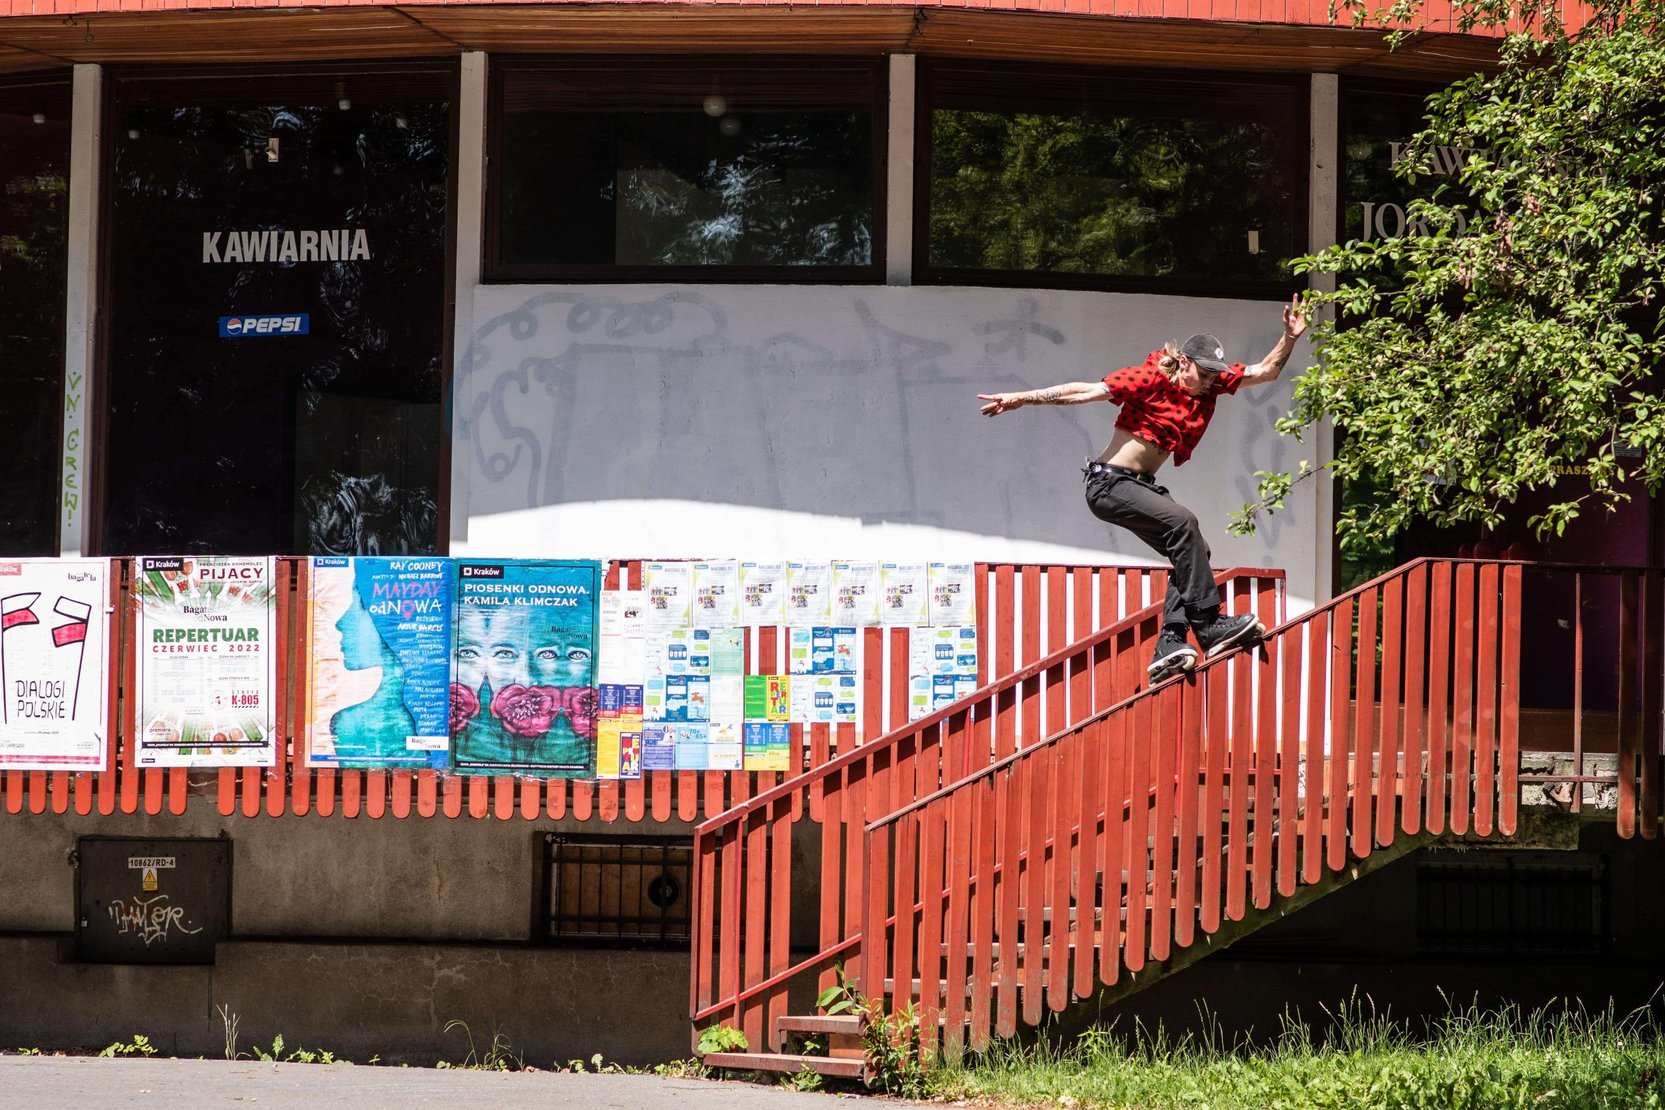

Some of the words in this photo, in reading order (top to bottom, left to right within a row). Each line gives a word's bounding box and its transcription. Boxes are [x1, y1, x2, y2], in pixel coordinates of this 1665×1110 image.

[202, 228, 371, 263] KAWIARNIA
[242, 316, 301, 334] PEPSI
[155, 560, 180, 568] Kraków
[324, 558, 346, 566] Kraków
[390, 561, 408, 571] RAY
[408, 561, 444, 571] COONEY
[200, 567, 264, 580] PIJACY
[473, 567, 500, 576] Kraków
[372, 580, 445, 599] MAYDAY
[464, 583, 525, 593] PIOSENKI
[528, 585, 590, 595] ODNOWA.
[464, 596, 511, 605] KAMILA
[514, 597, 578, 606] KLIMCZAK
[153, 627, 260, 643] REPERTUAR
[152, 645, 218, 653] CZERWIEC
[229, 644, 260, 652] 2022
[15, 680, 65, 699] DIALOGI
[231, 694, 259, 706] K-805
[17, 700, 65, 719] POLSKIE
[130, 858, 174, 867] 10862/RD-4
